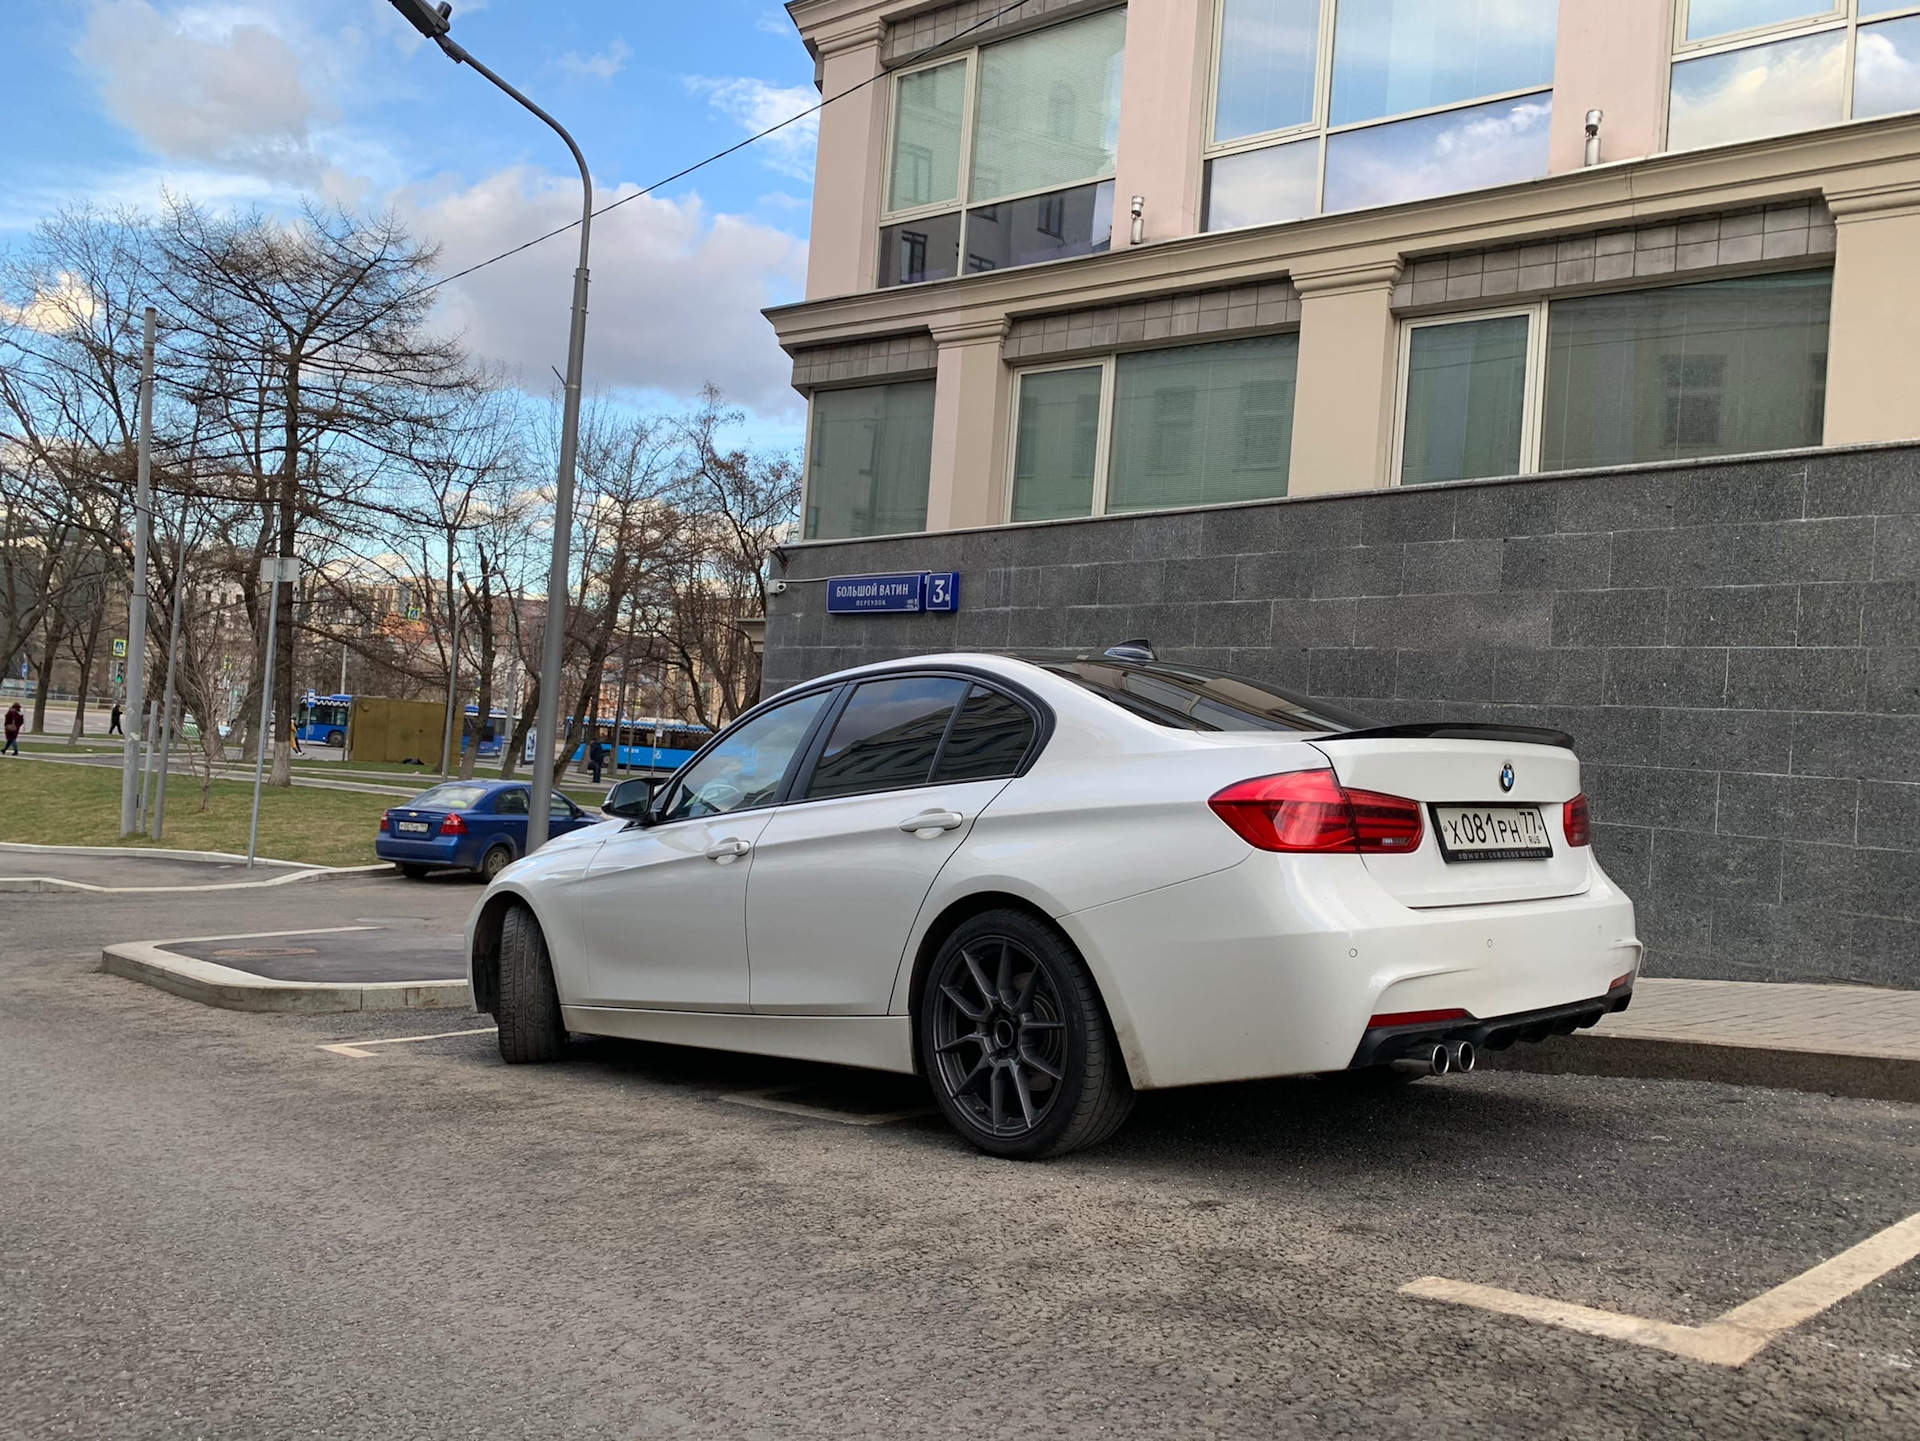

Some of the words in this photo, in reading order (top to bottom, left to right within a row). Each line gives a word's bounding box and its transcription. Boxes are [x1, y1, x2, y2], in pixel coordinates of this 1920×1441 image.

[836, 583, 878, 597] БОЛЬШОЙ
[879, 583, 909, 597] ВАТИН
[855, 599, 887, 607] ПЕРЕУЛОК
[1519, 811, 1537, 834] 77
